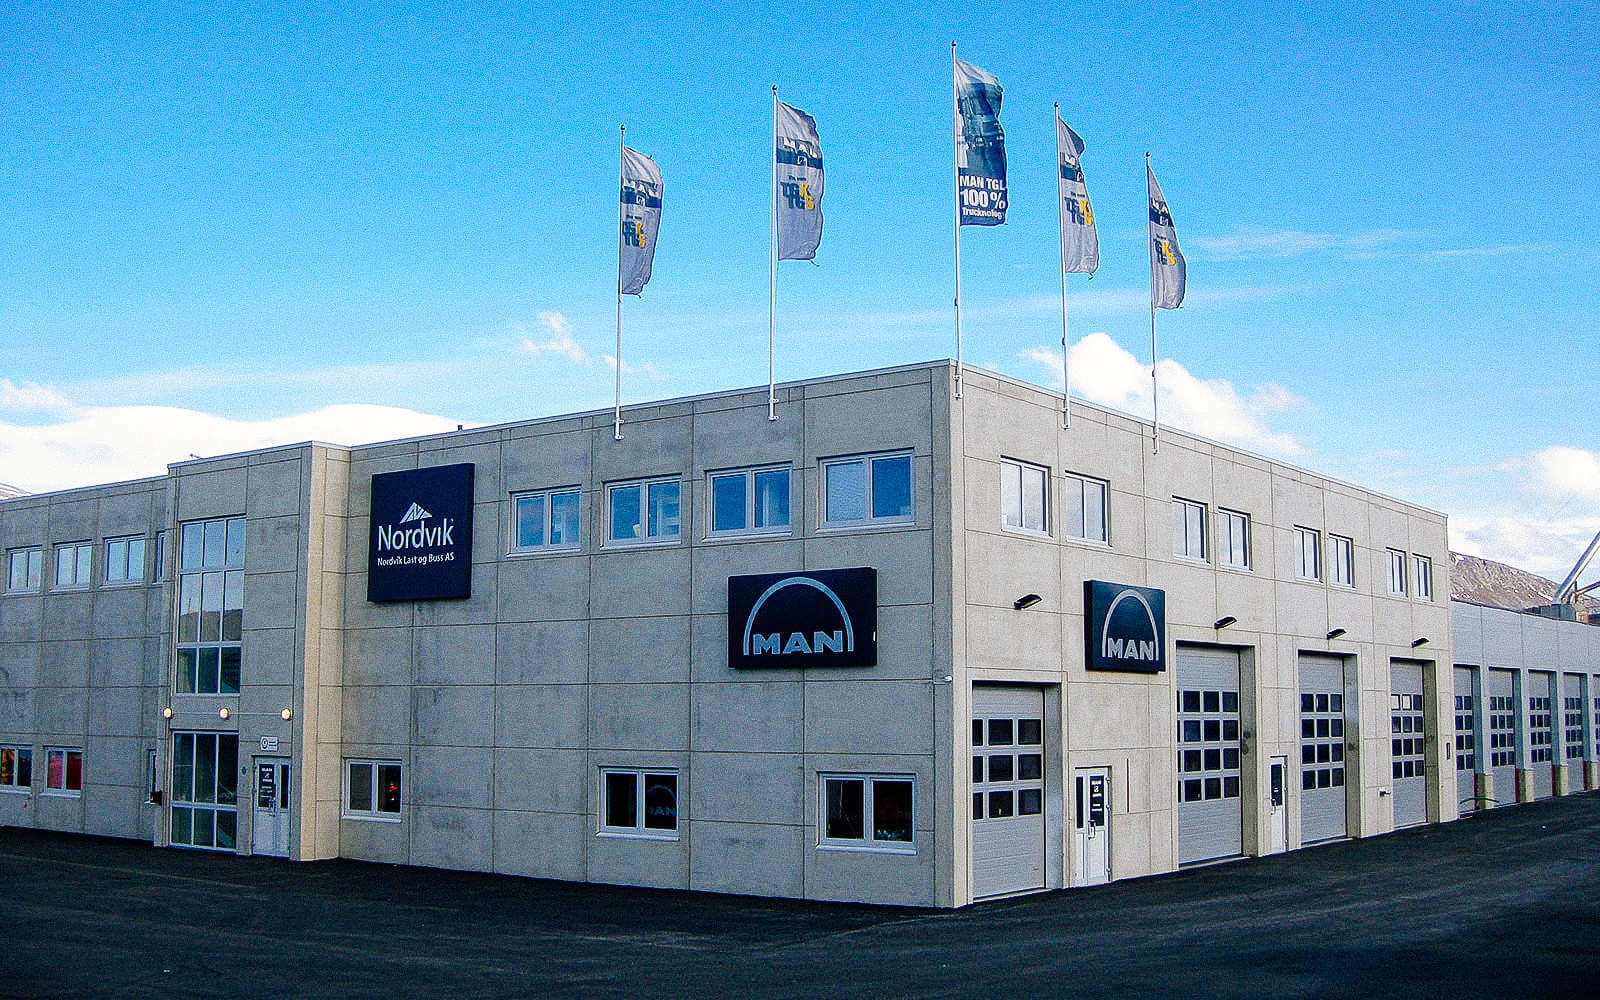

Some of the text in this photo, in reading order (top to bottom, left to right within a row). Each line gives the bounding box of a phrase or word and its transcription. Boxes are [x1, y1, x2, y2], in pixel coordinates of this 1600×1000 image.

[960, 176, 1005, 190] MAN TGL
[378, 518, 454, 551] Nordvik
[377, 556, 403, 566] Nordvik
[418, 556, 427, 566] og
[428, 553, 444, 563] Buss
[445, 551, 455, 562] AS
[752, 630, 843, 655] MAN
[1107, 637, 1154, 661] MAN
